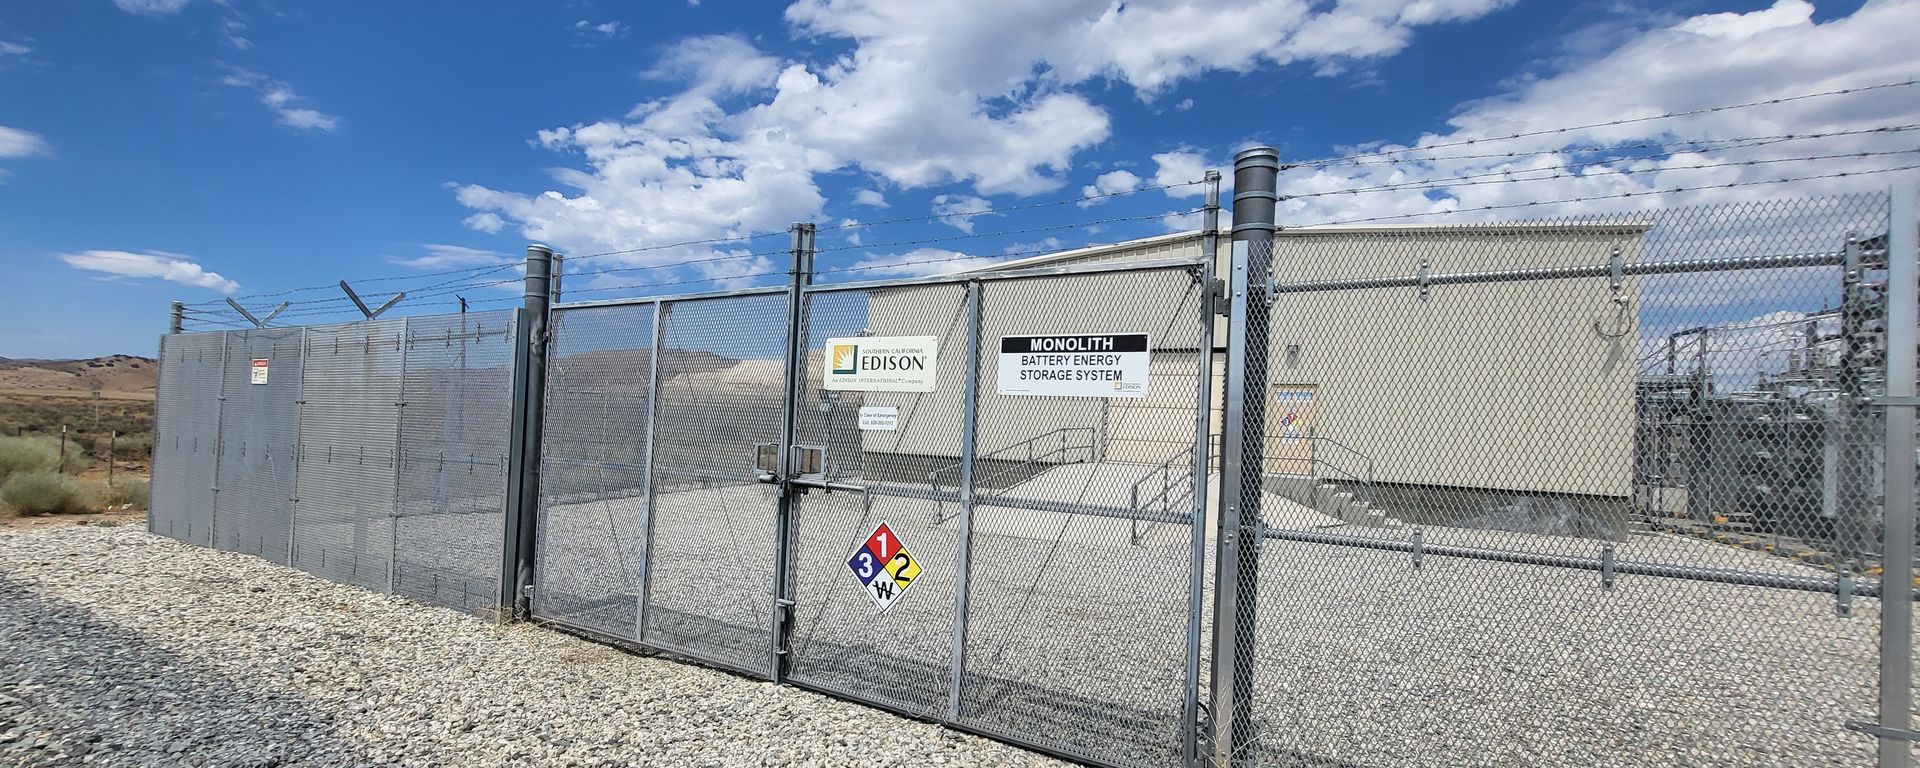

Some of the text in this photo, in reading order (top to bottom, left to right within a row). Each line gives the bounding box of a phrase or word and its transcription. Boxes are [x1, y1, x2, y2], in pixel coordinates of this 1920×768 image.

[1030, 337, 1114, 352] MONOLITH
[862, 355, 924, 371] EDISON
[1021, 354, 1122, 366] BATTERY ENERGY
[1020, 369, 1123, 381] STORAGE SYSTEM
[876, 532, 887, 558] 1
[858, 552, 873, 578] 3
[894, 553, 910, 582] 2
[874, 580, 895, 600] W
